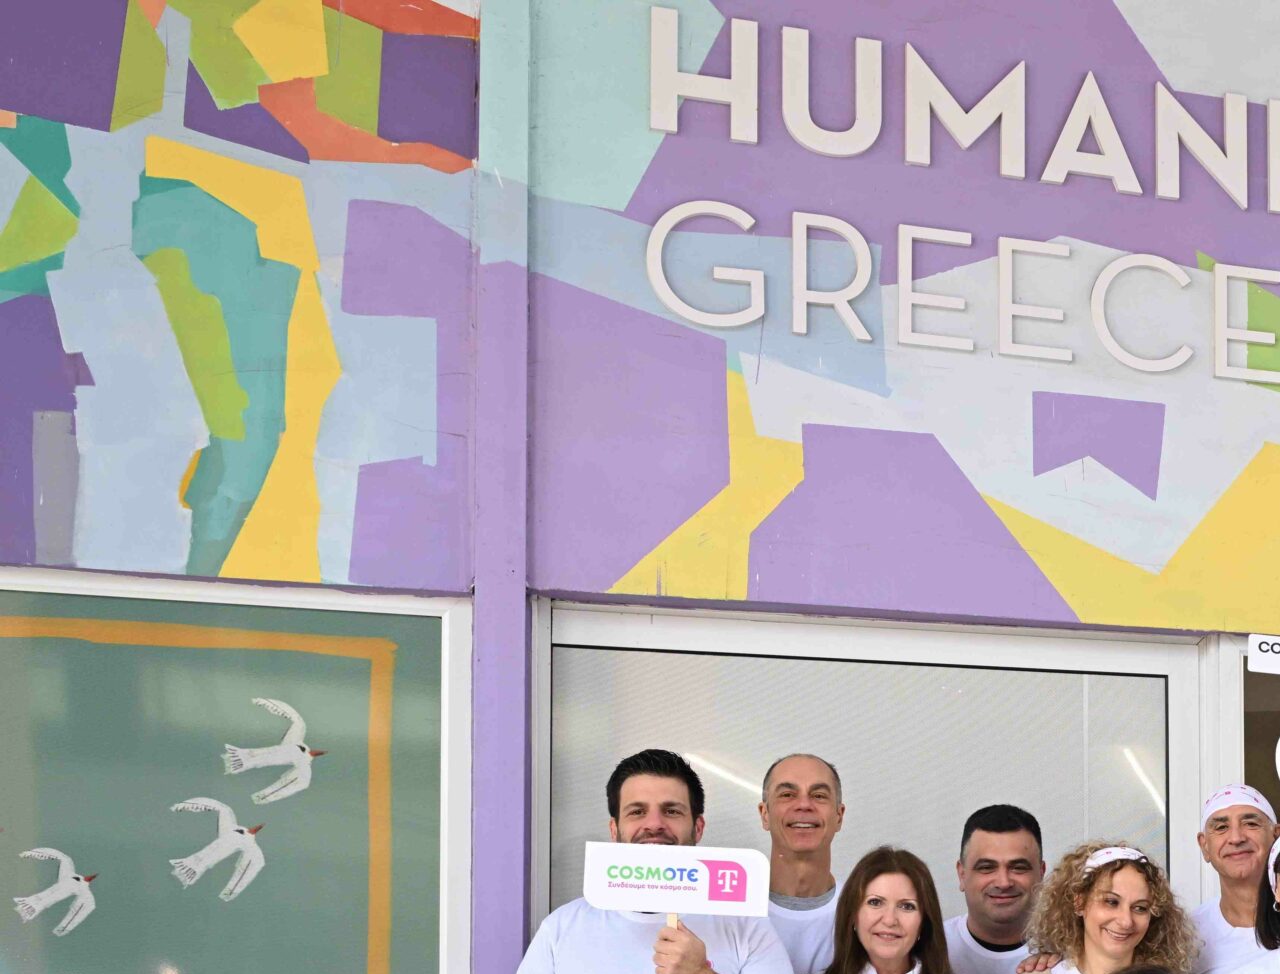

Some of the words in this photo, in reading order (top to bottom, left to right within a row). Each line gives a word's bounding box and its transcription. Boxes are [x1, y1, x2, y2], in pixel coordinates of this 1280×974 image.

[607, 865, 698, 882] COSMOTE
[608, 881, 646, 890] Συνδέουμε
[660, 883, 682, 892] κόσμο
